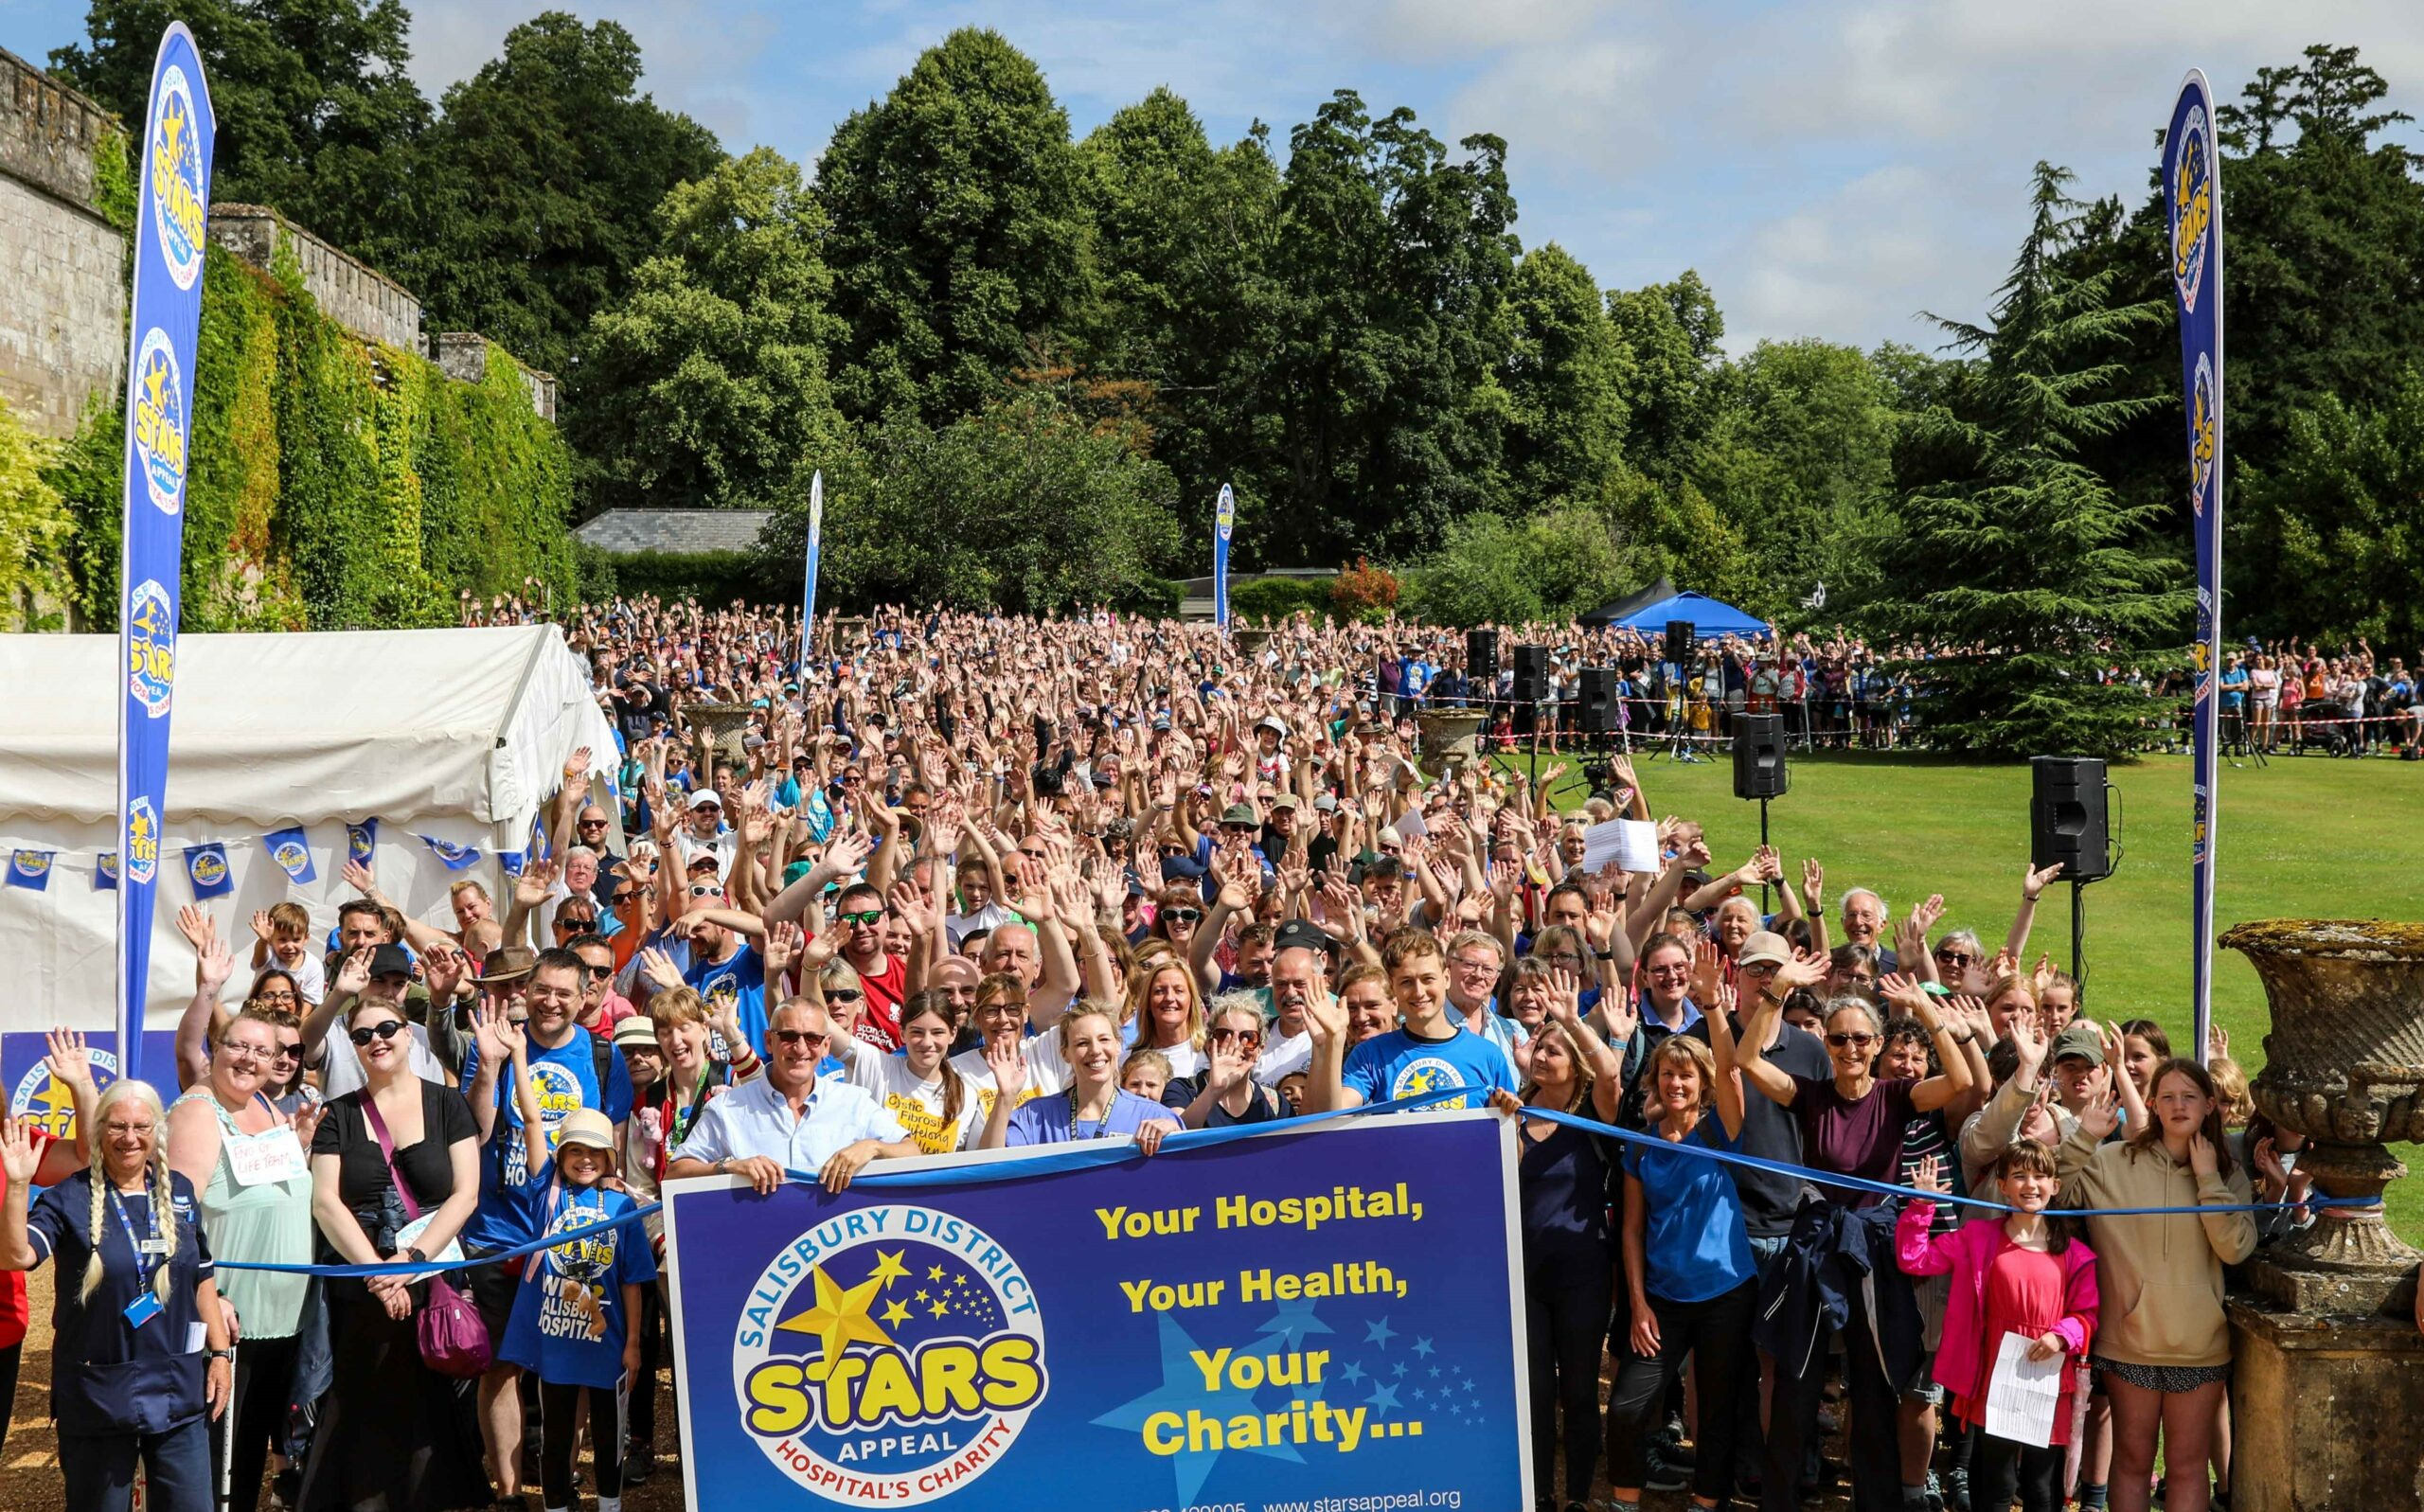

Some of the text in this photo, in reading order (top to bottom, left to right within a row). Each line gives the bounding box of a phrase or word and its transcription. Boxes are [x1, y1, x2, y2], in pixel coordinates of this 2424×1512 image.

[154, 145, 204, 251] STARS
[166, 224, 187, 261] APPEAL
[151, 465, 177, 489] APPEAL
[2196, 682, 2211, 701] ARIT
[195, 863, 226, 881] STARS
[855, 1031, 897, 1050] charter
[857, 1023, 889, 1039] stand
[15, 1065, 45, 1106] SALIS
[1396, 1059, 1463, 1090] SALISBURY DISTRIC
[514, 1094, 580, 1112] ARS
[888, 1094, 923, 1112] Cystic
[234, 1142, 273, 1160] END OF
[238, 1159, 260, 1174] LIFE
[1095, 1183, 1423, 1240] Your Hospital,
[740, 1208, 1037, 1348] SALISBURY DISTRICT
[1119, 1260, 1408, 1313] Your Health,
[542, 1296, 603, 1321] ALISBU
[1189, 1347, 1329, 1392] Your
[748, 1338, 1041, 1433] STARS
[1142, 1399, 1423, 1456] Charity...
[775, 1417, 1011, 1501] HOSPITAL'S CHARITY
[837, 1432, 957, 1463] APPEAL
[1263, 1488, 1461, 1512] www.starsappeal.org
